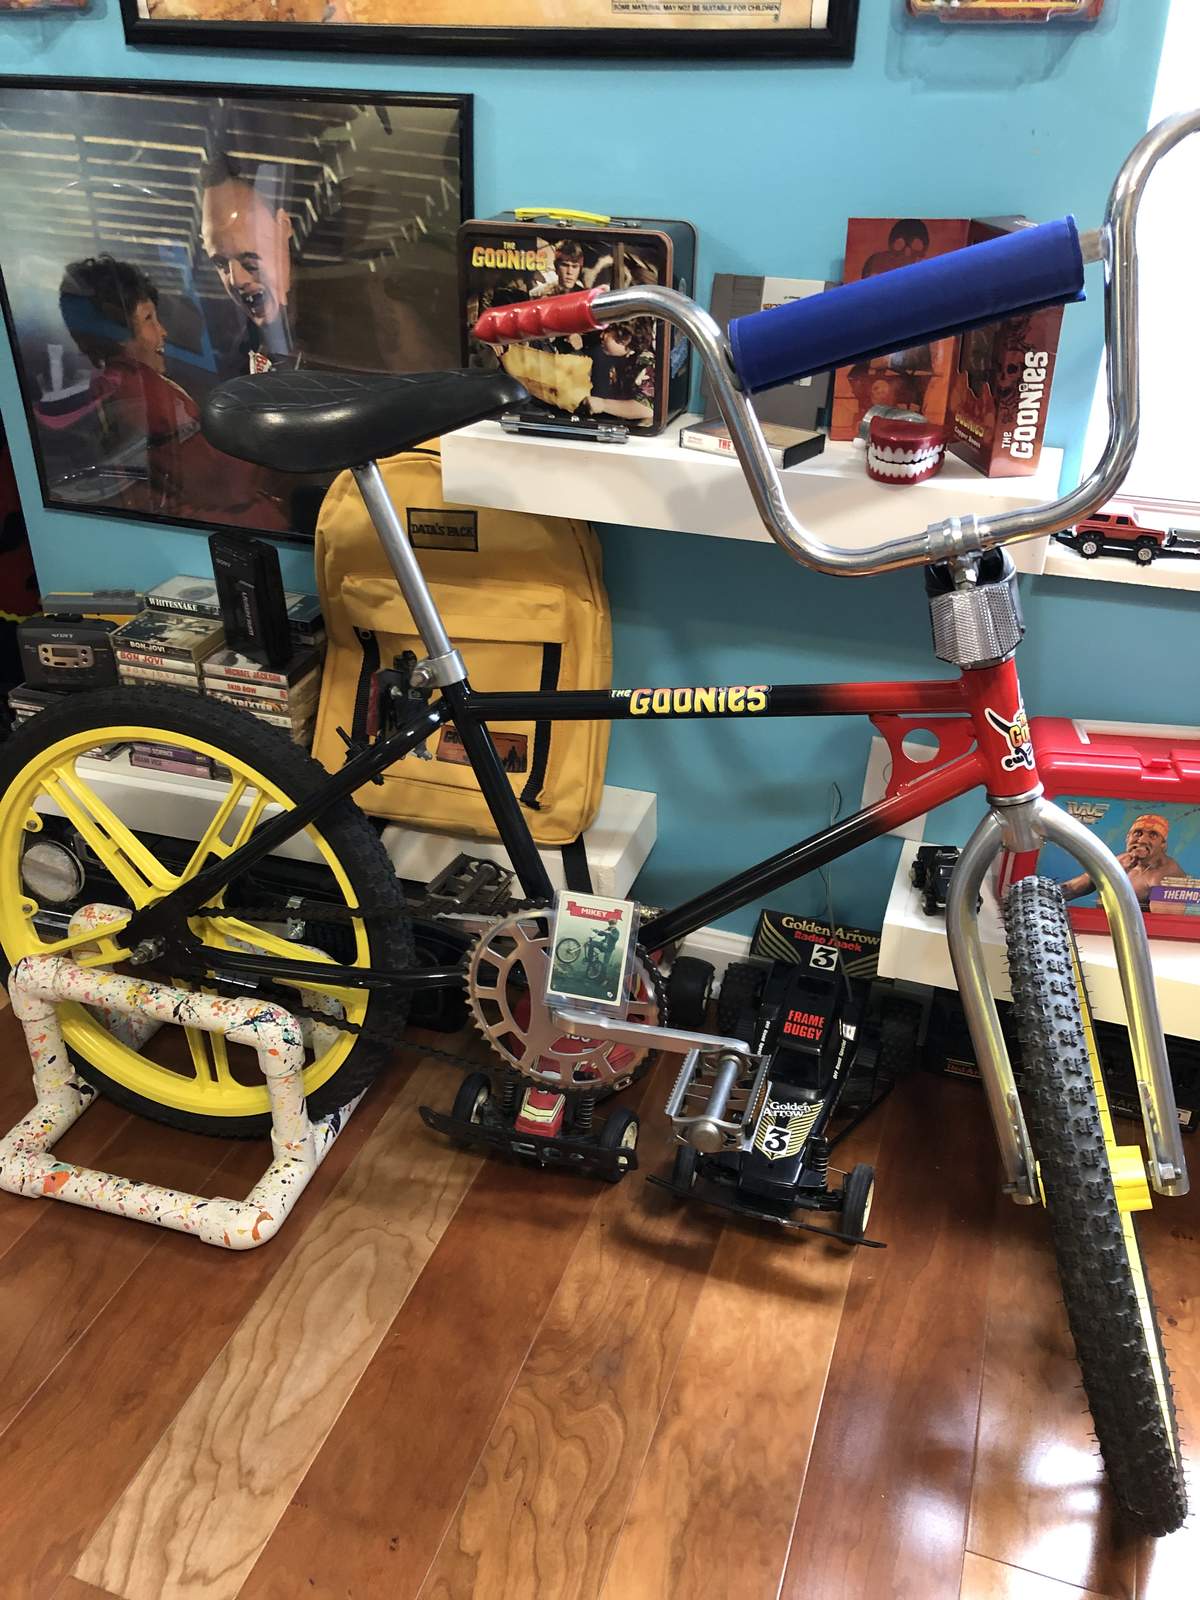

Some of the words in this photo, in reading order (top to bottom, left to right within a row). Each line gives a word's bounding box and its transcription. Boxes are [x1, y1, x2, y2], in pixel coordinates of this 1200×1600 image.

[149, 597, 198, 612] WHITESNAKE
[120, 652, 140, 660] BON
[143, 656, 165, 666] JOVI
[1163, 890, 1200, 903] THERMO
[581, 908, 608, 918] MIKEY
[781, 916, 831, 937] Golden
[835, 927, 881, 945] Arrow
[793, 930, 826, 945] Radio
[811, 946, 838, 968] 3
[787, 1009, 826, 1029] FRAME
[783, 1021, 823, 1041] BUGGY
[763, 1107, 804, 1118] Arrow
[770, 1101, 811, 1112] Golden
[765, 1128, 790, 1152] 3
